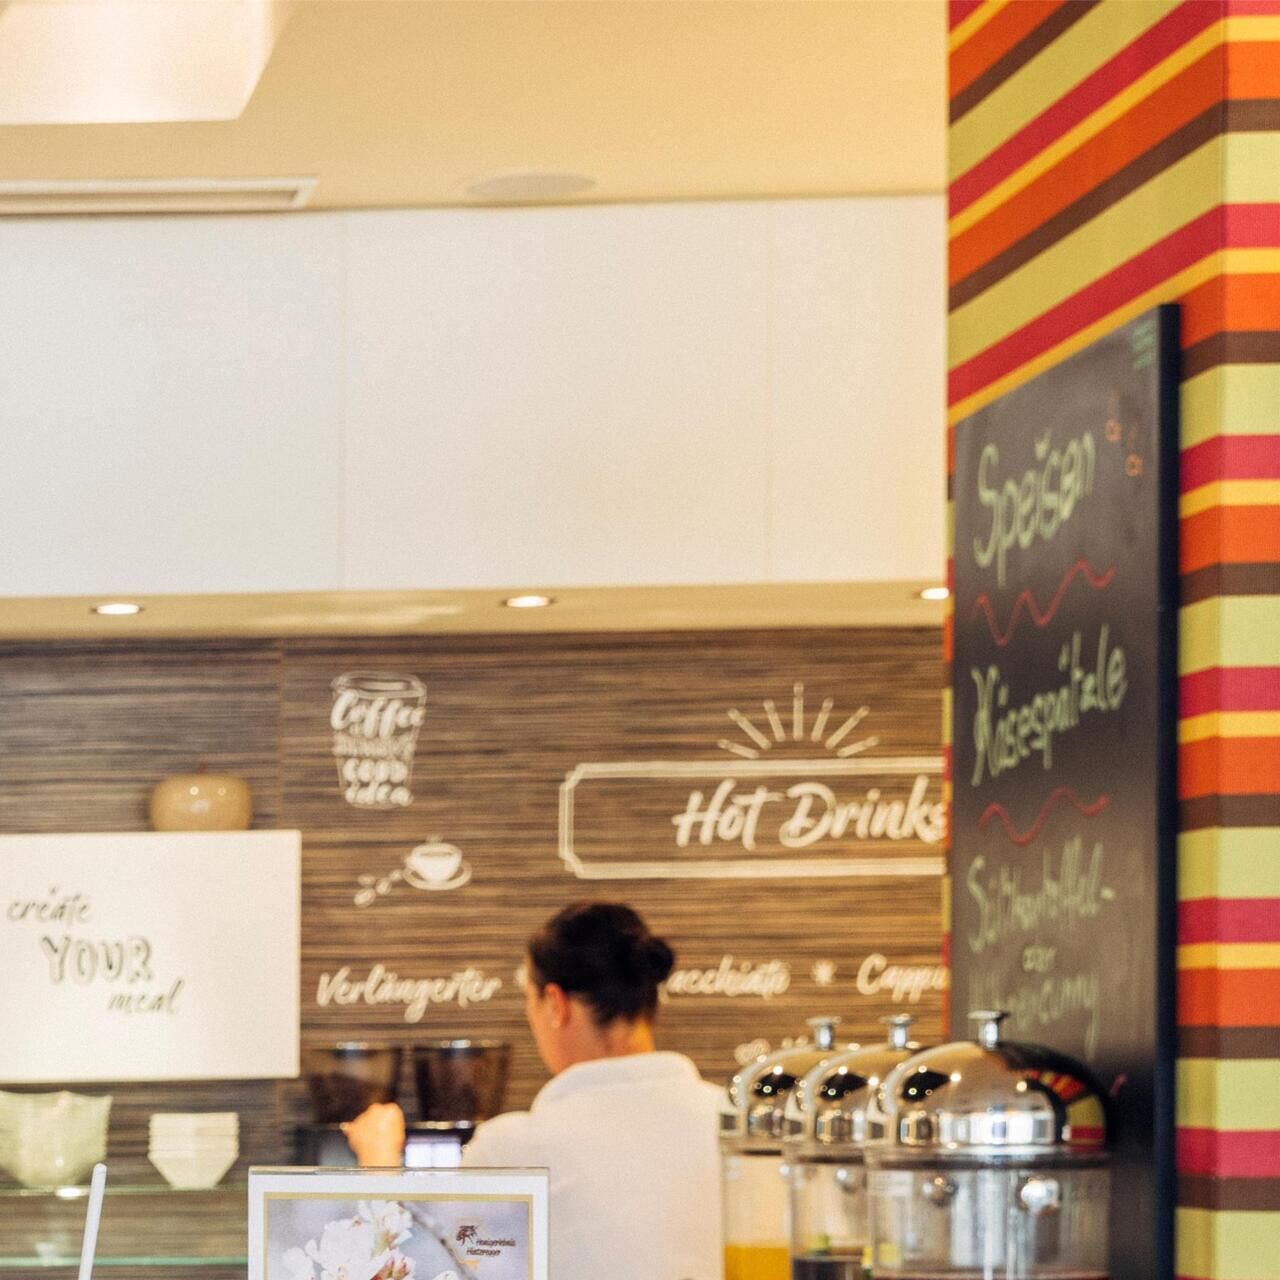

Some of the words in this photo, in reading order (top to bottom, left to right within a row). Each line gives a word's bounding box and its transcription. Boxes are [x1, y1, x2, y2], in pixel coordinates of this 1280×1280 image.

[973, 430, 1096, 587] Speisen
[330, 689, 426, 738] Coffee
[671, 778, 785, 850] Hot
[7, 886, 90, 926] create
[41, 934, 153, 984] YOUR
[108, 976, 184, 1014] meal
[316, 964, 502, 1023] Verlängerter
[657, 955, 790, 1000] acchiato
